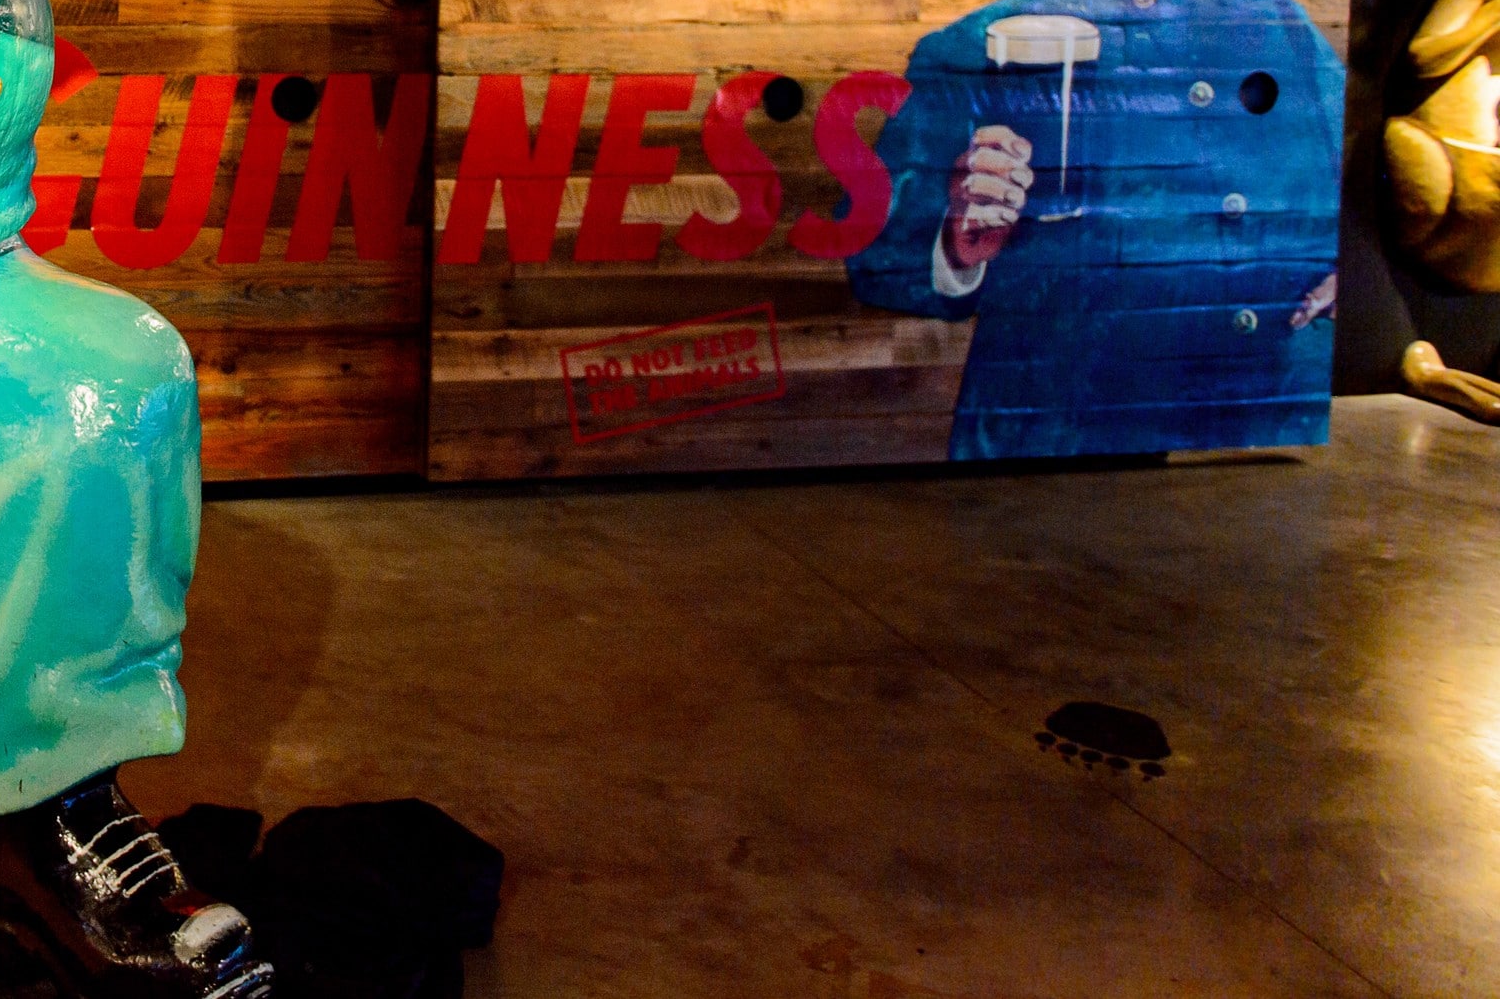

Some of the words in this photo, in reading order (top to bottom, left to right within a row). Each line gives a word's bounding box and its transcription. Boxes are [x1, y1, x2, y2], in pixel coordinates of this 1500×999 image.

[585, 357, 622, 387] DO
[631, 344, 684, 376] NOT
[693, 327, 757, 361] FEED
